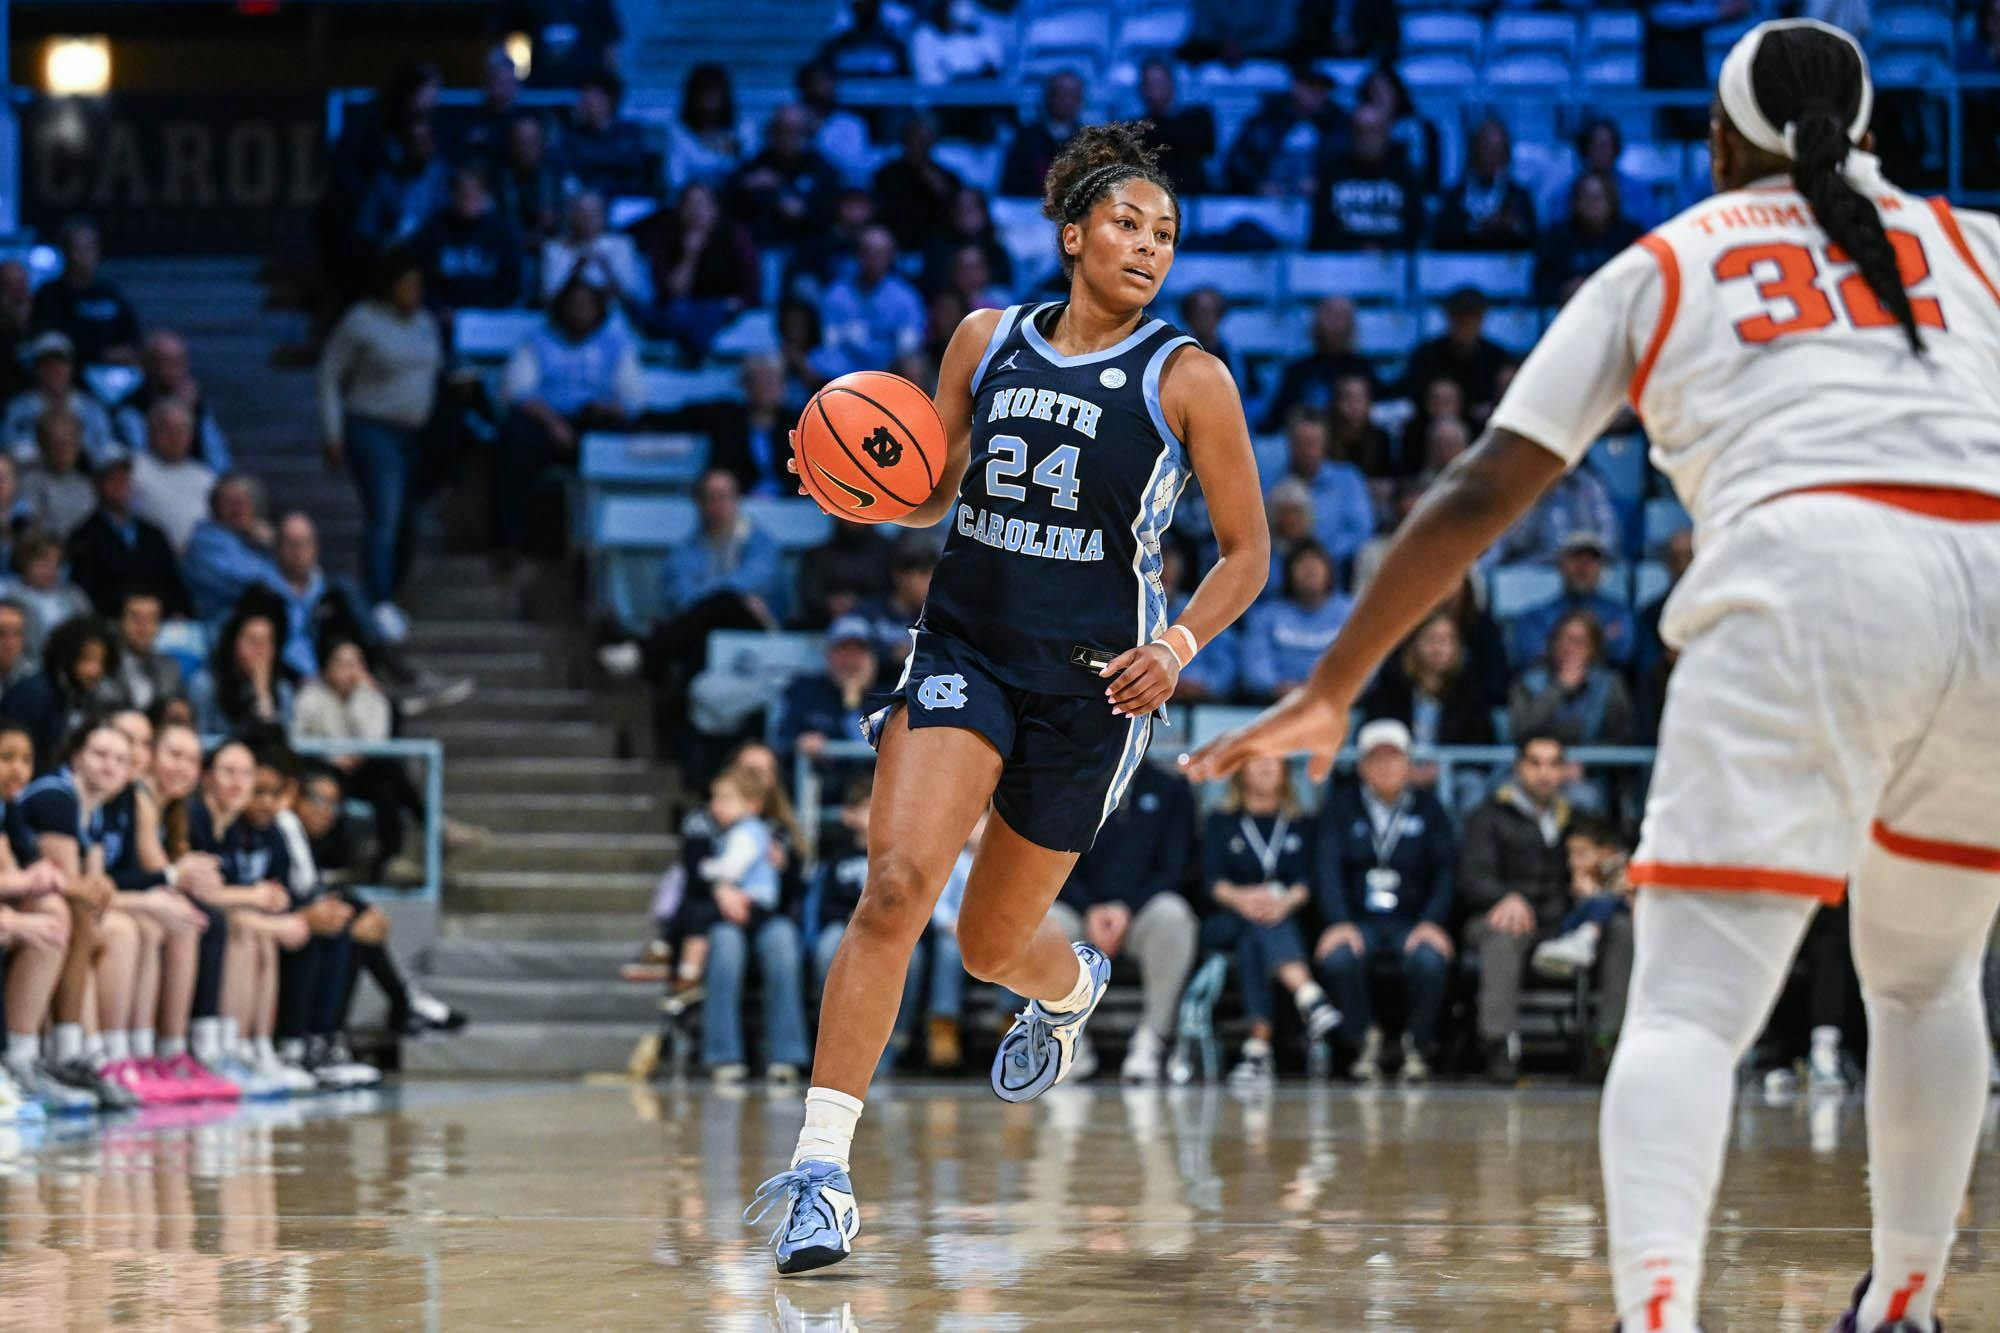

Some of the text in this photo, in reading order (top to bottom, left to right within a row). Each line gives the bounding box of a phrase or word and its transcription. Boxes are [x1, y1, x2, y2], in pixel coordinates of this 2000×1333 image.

[1690, 194, 1903, 236] THOMN
[1712, 227, 1948, 344] 32
[987, 387, 1103, 439] NORTH
[985, 434, 1081, 511] 24
[957, 503, 1104, 561] CAROLINA
